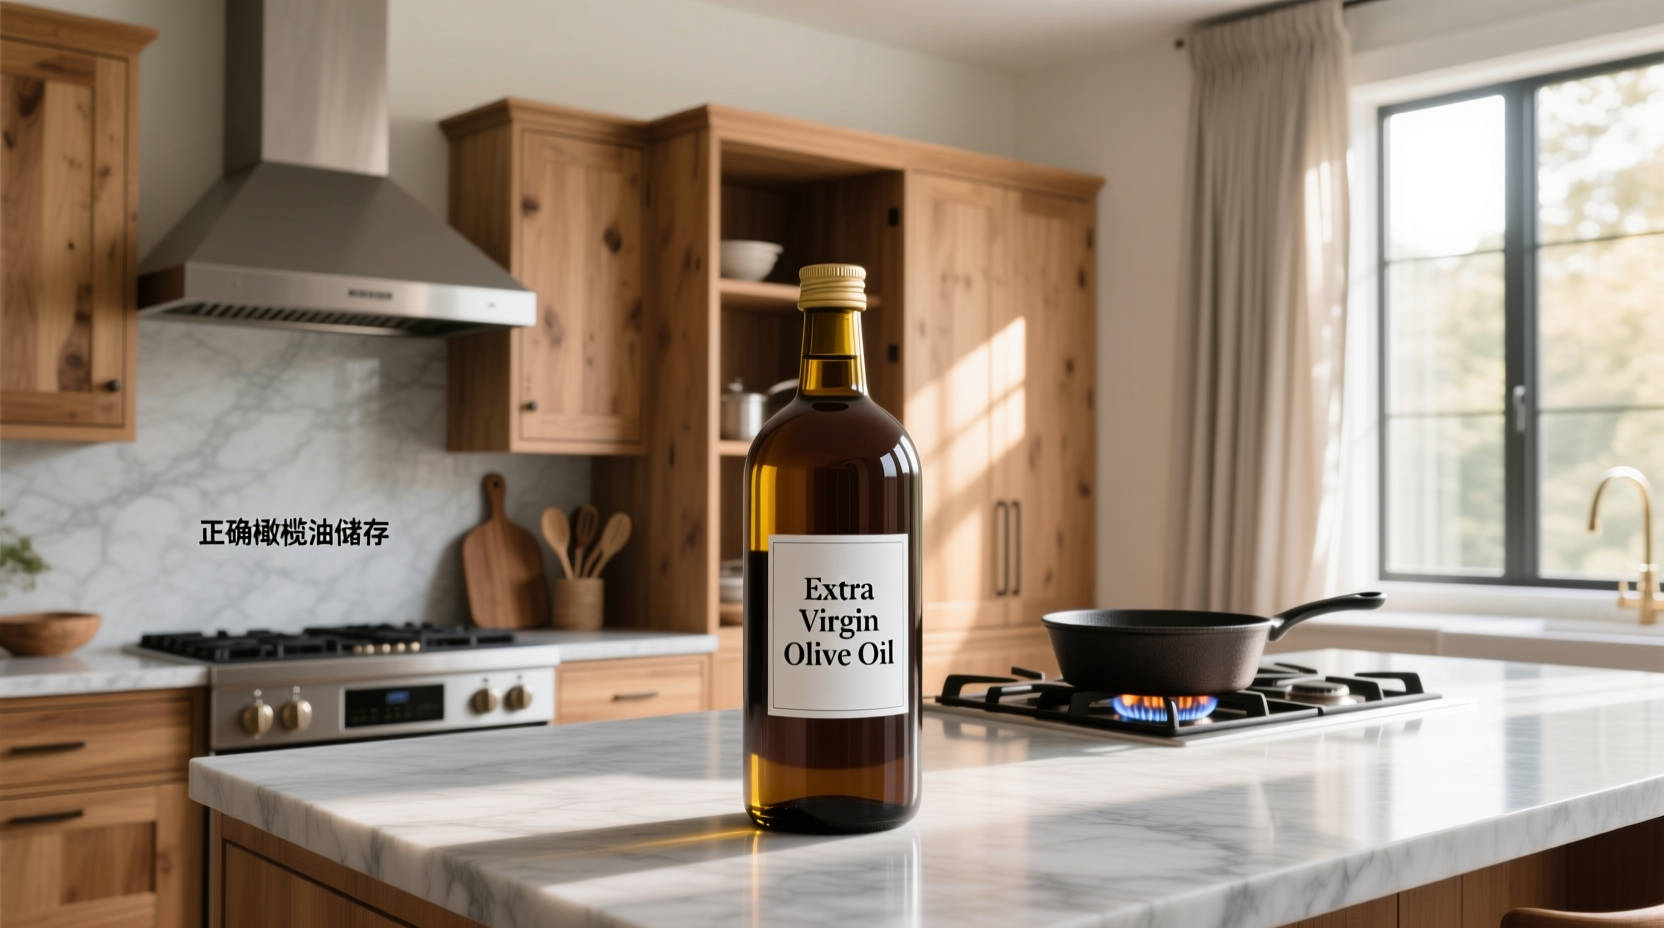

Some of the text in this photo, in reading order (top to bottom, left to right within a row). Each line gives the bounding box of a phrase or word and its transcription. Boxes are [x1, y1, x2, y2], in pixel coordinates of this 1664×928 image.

[803, 576, 875, 601] Extra
[798, 607, 880, 640] Virgin
[783, 639, 895, 667] Olive Oil
